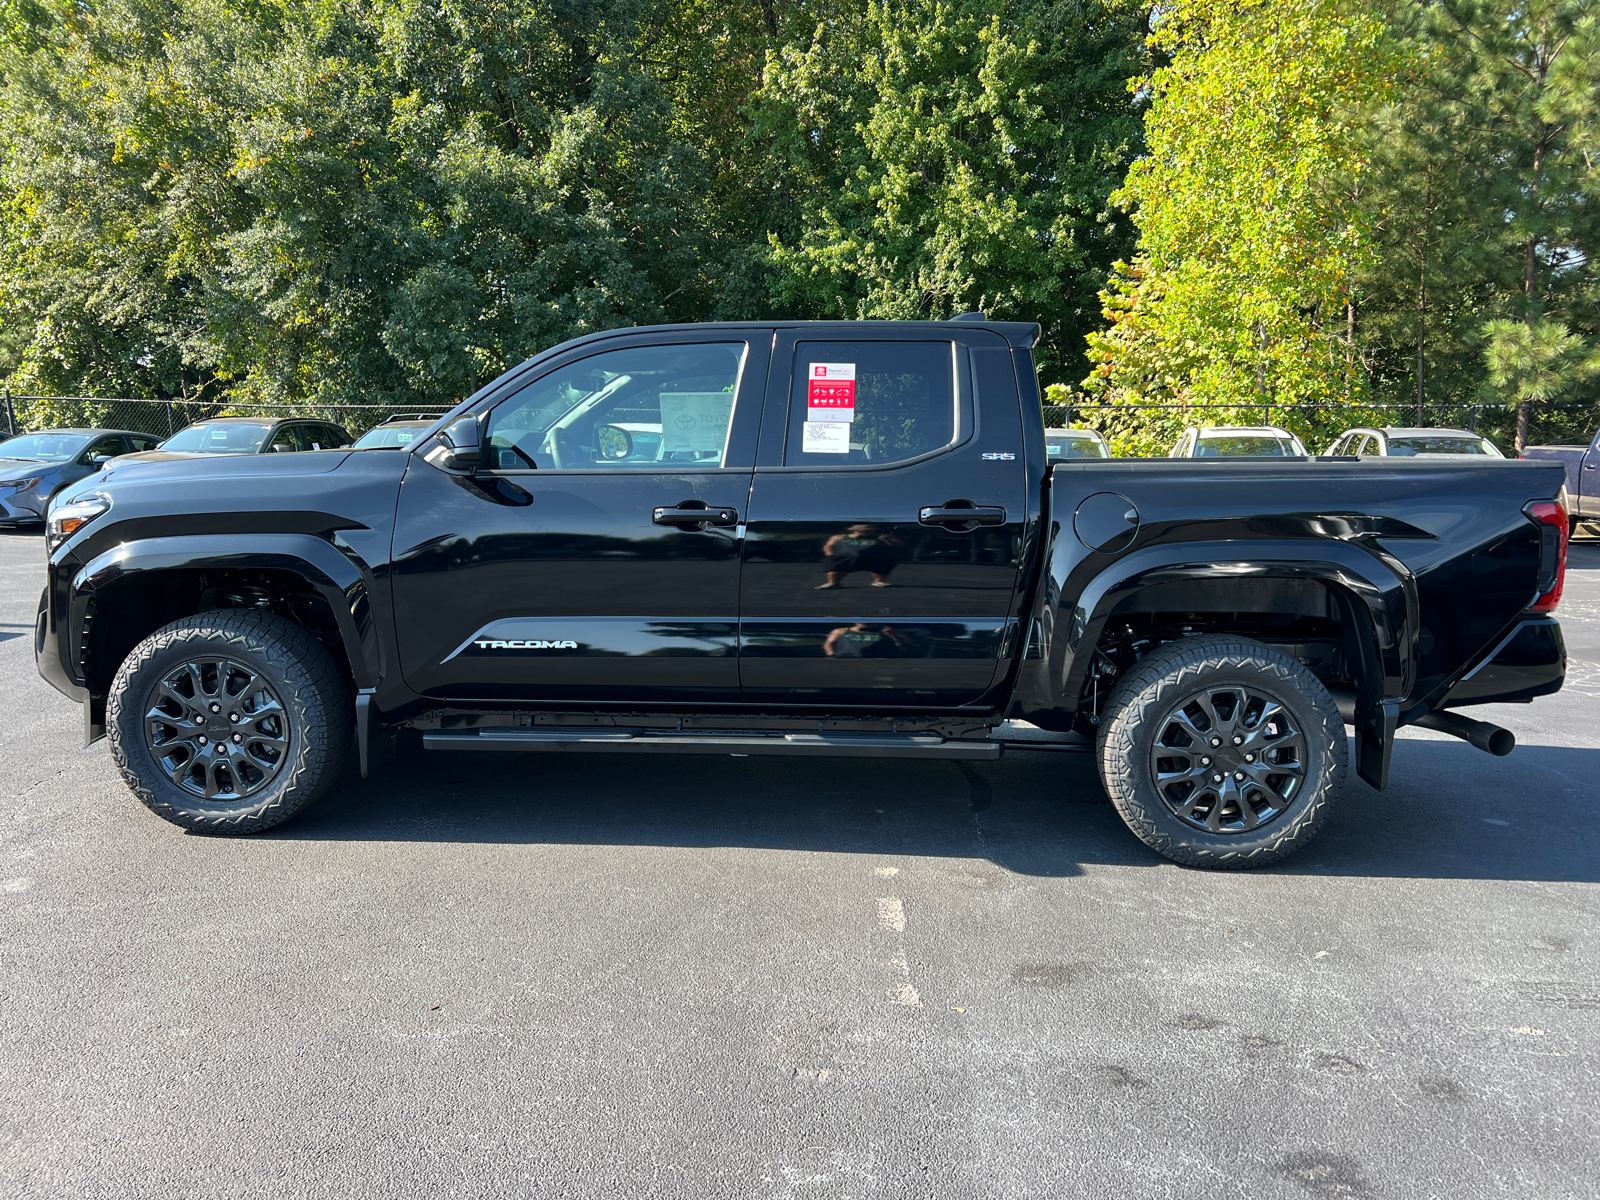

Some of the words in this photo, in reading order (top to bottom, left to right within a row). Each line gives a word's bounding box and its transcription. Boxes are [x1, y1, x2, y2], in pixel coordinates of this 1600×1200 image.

[698, 414, 729, 422] TOYO
[981, 452, 1016, 460] SR5
[474, 640, 578, 649] TACOMA
